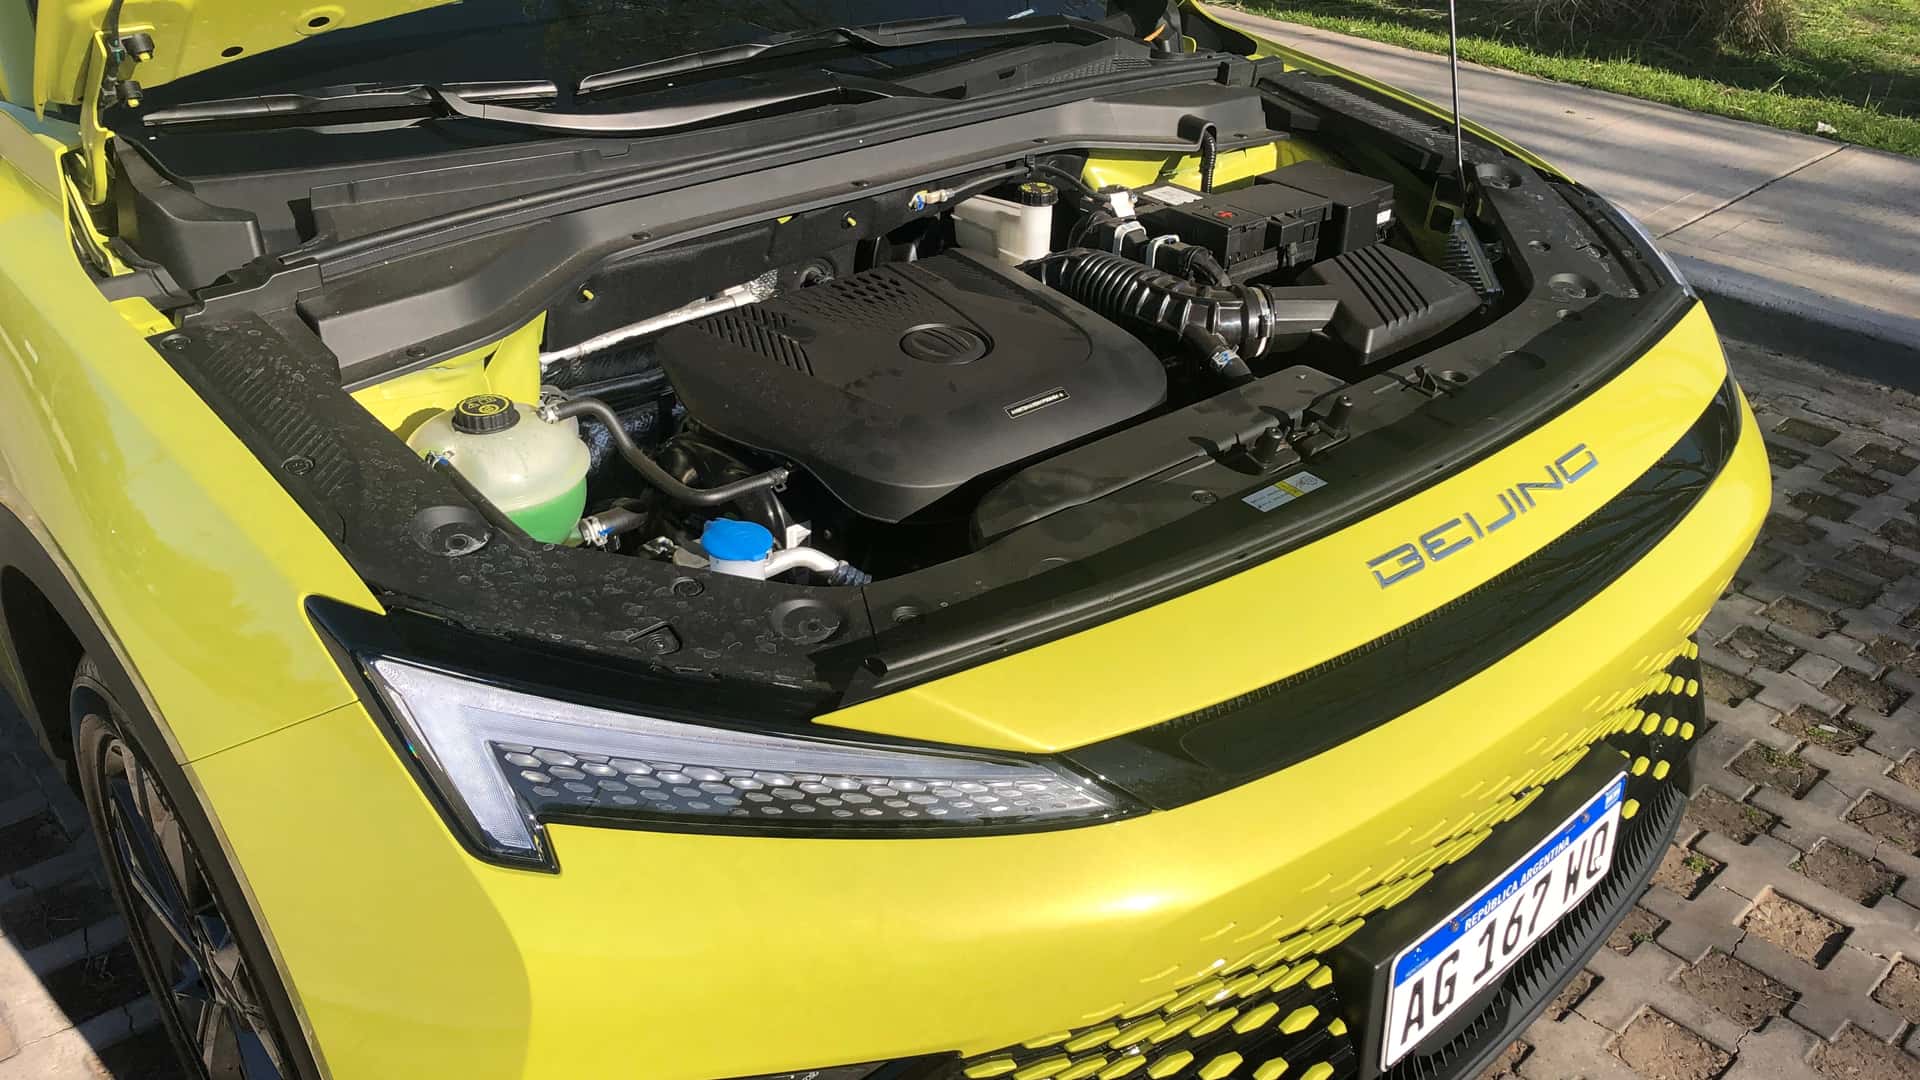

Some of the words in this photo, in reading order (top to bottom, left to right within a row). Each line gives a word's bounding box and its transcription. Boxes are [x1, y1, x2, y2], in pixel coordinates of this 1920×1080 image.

[1366, 443, 1599, 588] BEIJING
[1400, 949, 1460, 1045] AG
[1473, 869, 1553, 985] 167
[1564, 820, 1609, 904] WQ
[1464, 880, 1519, 932] REPÚBLICA
[1520, 836, 1570, 886] ARGENTINA
